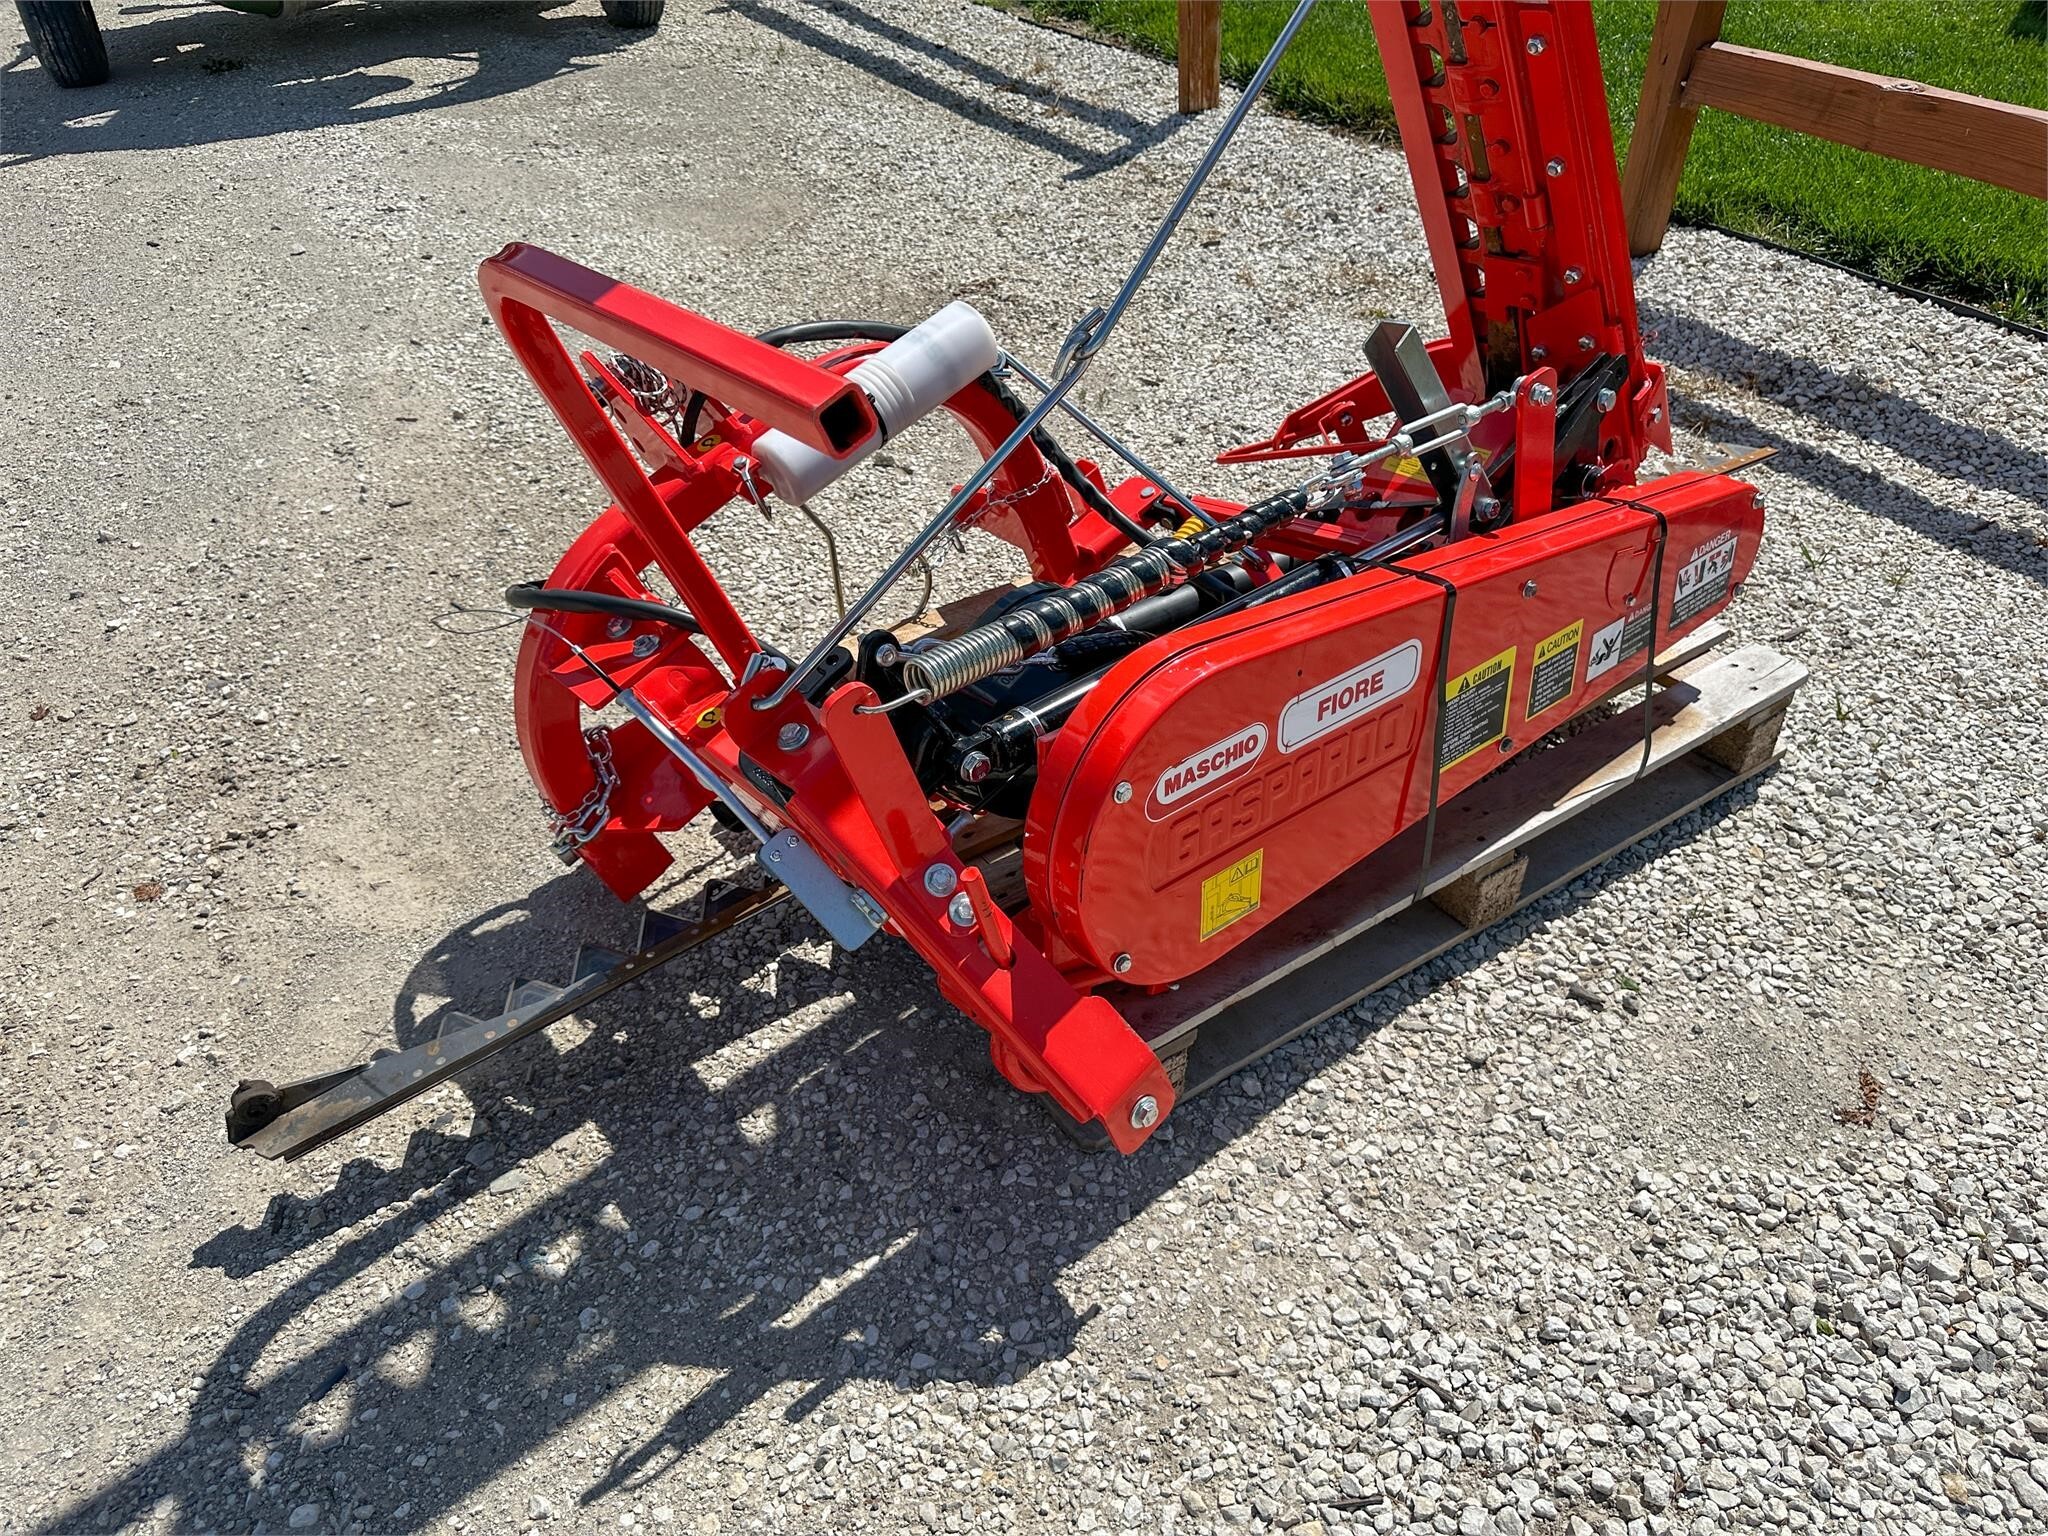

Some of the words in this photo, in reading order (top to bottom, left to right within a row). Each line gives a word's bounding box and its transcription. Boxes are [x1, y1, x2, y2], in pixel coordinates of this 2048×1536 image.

[1698, 529, 1731, 557] DANGER
[1546, 626, 1579, 653] CAUTION
[1472, 660, 1502, 685] CAUTION
[1317, 670, 1385, 722] FIORE
[1164, 734, 1258, 797] MASCHIO
[1166, 704, 1417, 866] GASPARDO
